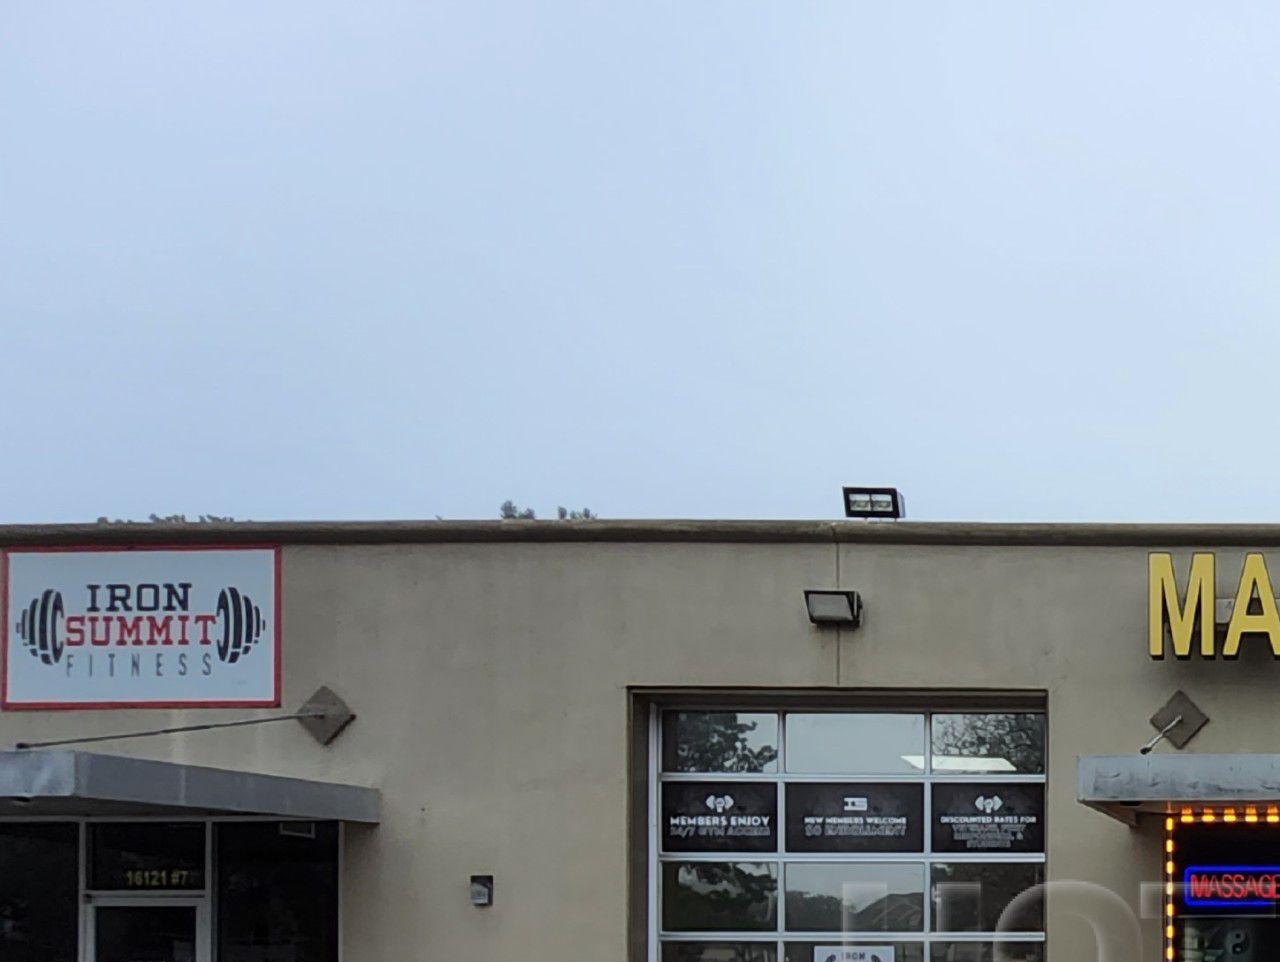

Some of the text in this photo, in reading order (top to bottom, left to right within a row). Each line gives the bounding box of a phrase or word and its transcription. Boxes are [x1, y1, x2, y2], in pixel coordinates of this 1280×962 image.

[86, 583, 192, 612] IRON
[65, 615, 217, 646] SUMMIT
[66, 653, 212, 677] FITNESS
[670, 816, 770, 826] MEMBERS ENJOY
[126, 869, 189, 886] 16121 #7
